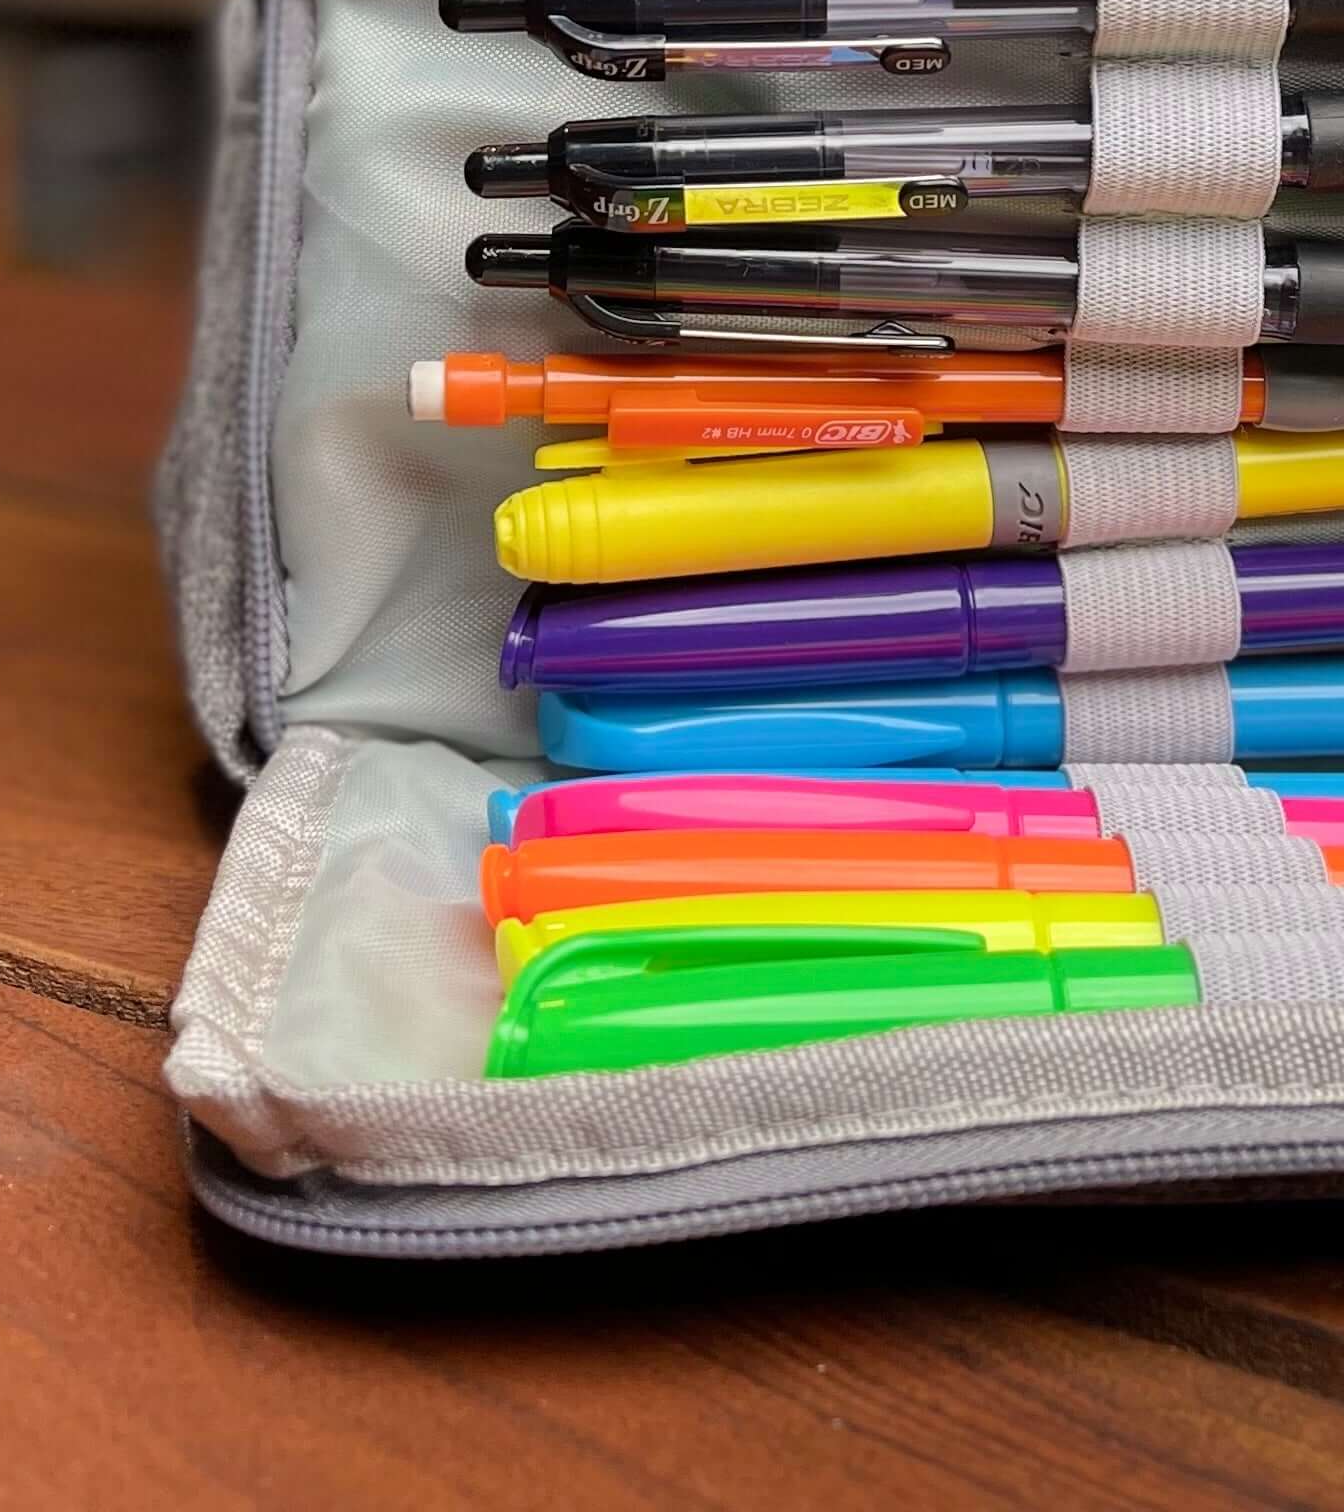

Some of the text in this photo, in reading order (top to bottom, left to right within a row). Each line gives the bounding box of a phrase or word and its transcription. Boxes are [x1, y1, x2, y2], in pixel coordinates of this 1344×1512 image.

[895, 56, 943, 71] MED
[716, 193, 849, 216] ZEBRA
[909, 194, 956, 209] MED
[758, 426, 812, 438] 07mm
[819, 424, 886, 442] BIC
